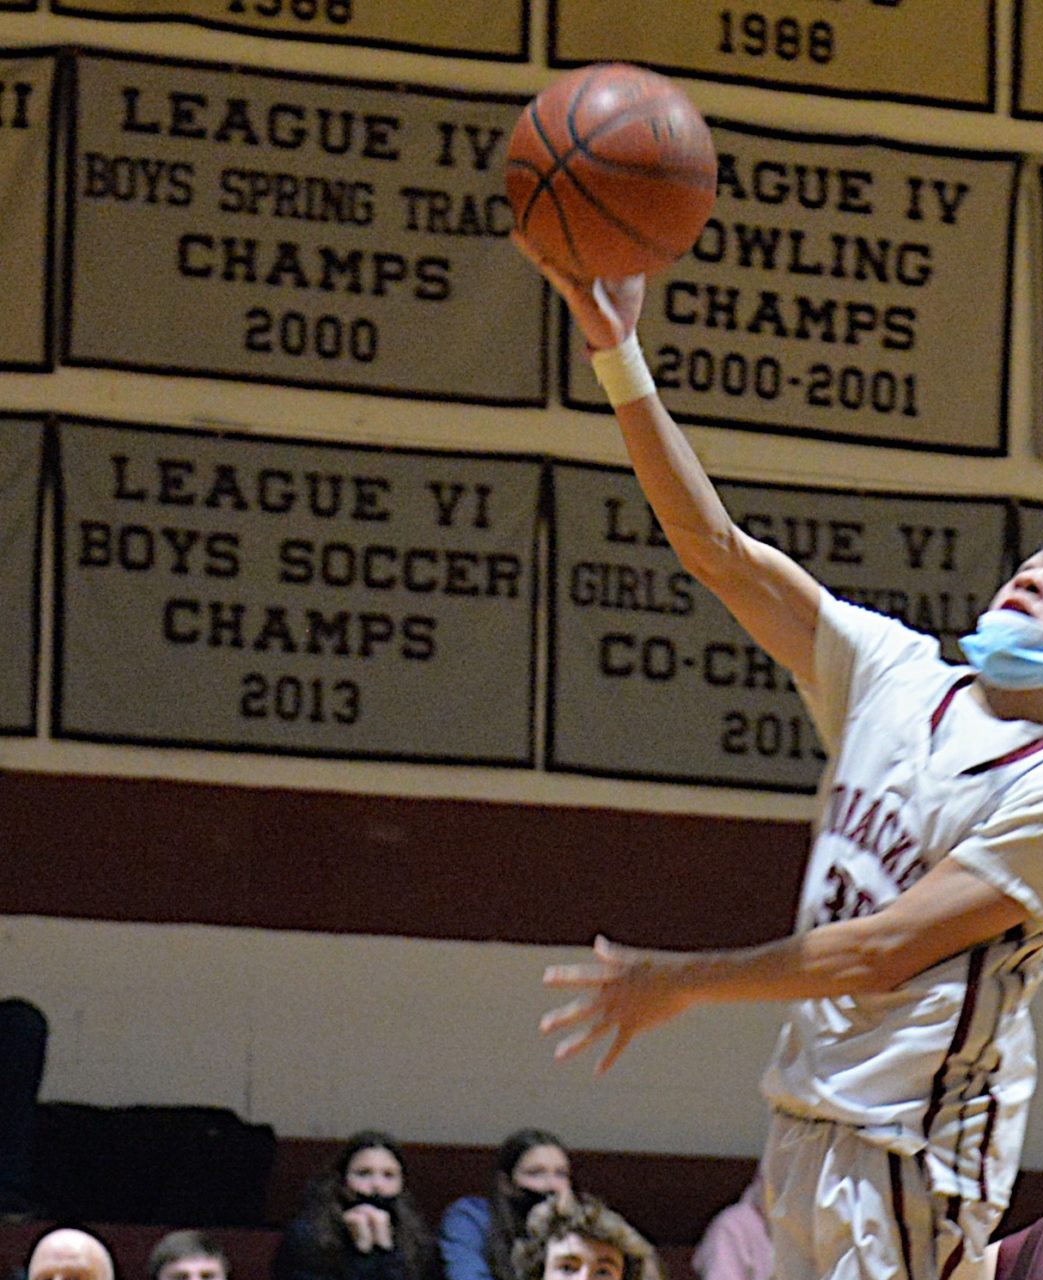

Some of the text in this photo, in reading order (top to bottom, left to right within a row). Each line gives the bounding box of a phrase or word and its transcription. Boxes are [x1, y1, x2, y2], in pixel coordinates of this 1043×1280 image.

[717, 10, 835, 63] 1988
[121, 87, 505, 171] LEAGUE IV
[83, 152, 515, 239] BOYS SPRING TRAC
[715, 153, 970, 226] AGUE IV
[177, 235, 453, 301] CHAMPS
[692, 219, 934, 288] OWLING
[244, 307, 379, 363] 2000
[664, 280, 917, 351] CHAMPS
[655, 345, 919, 417] 2000-2001
[110, 455, 492, 530] LEAGUE VI
[77, 520, 523, 599] BOYS SOCCER
[899, 523, 958, 572] VI
[569, 561, 695, 616] GIRLS
[162, 599, 437, 662] CHAMPS
[240, 672, 361, 726] 2013
[722, 710, 828, 763] 201
